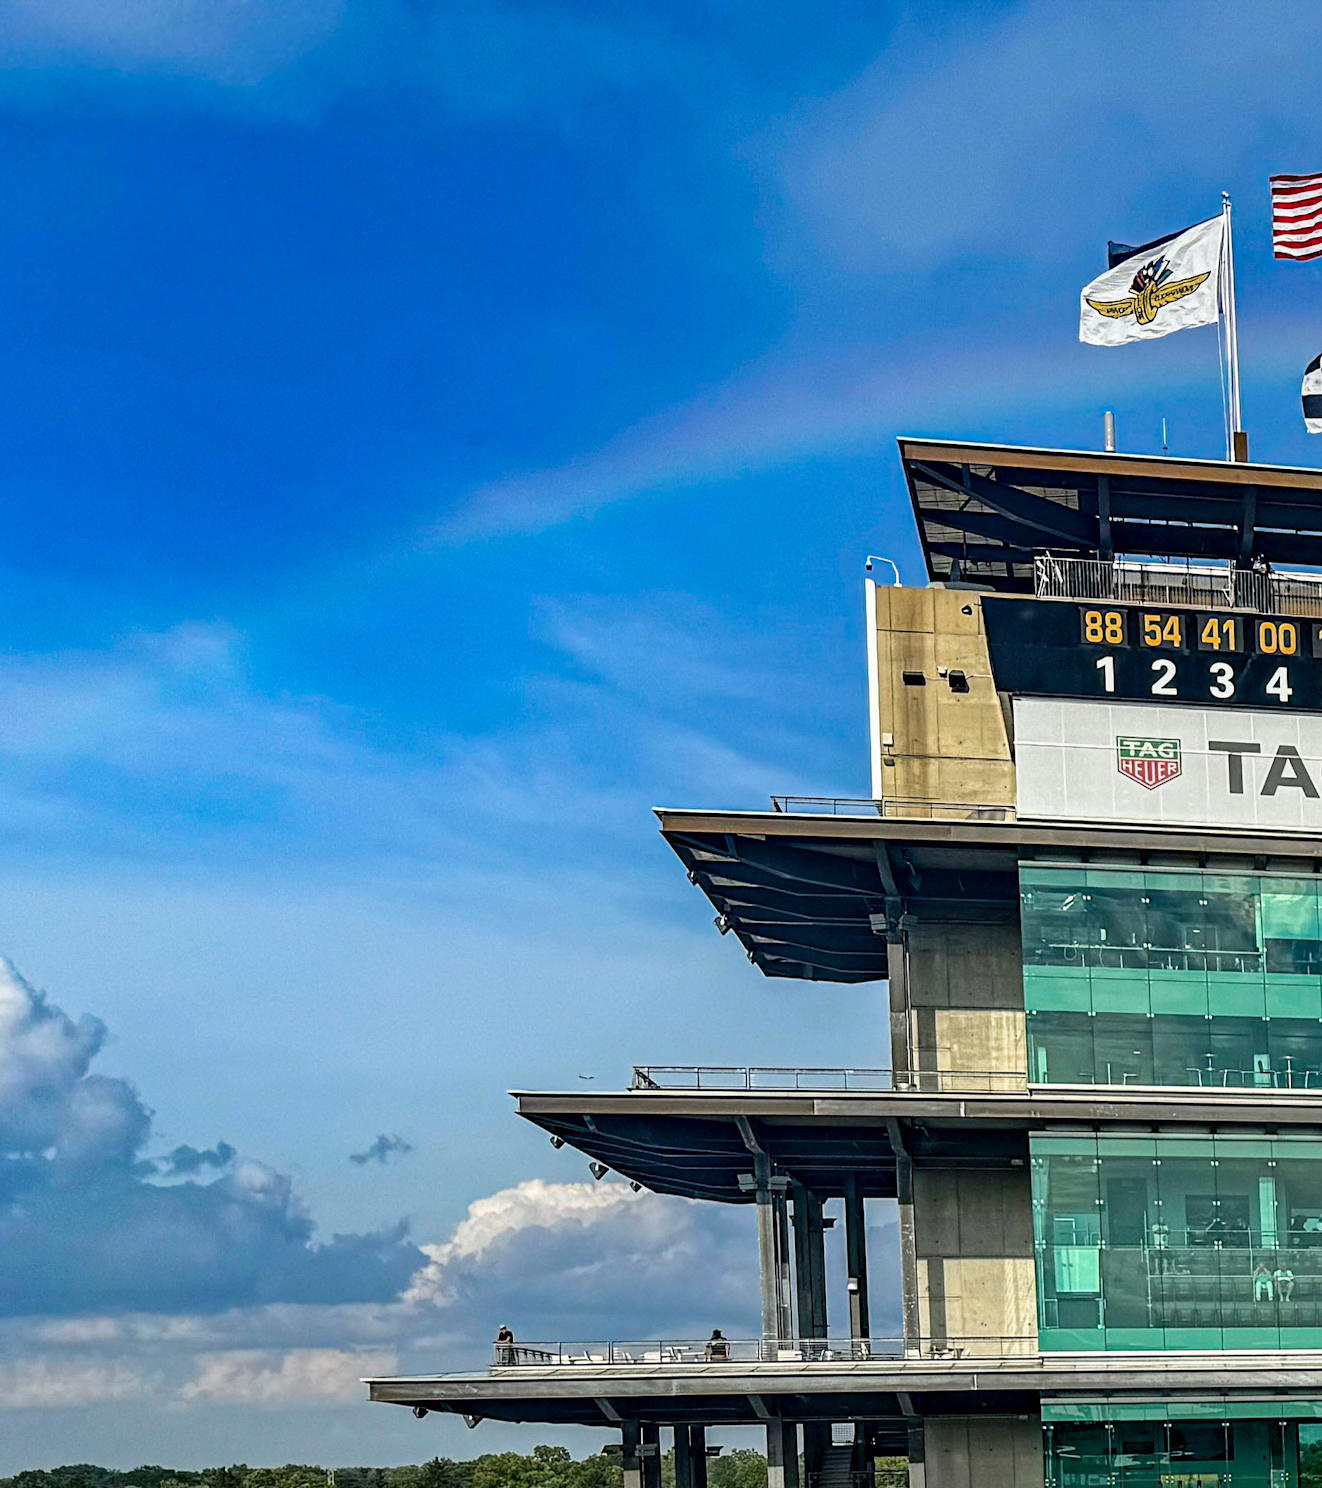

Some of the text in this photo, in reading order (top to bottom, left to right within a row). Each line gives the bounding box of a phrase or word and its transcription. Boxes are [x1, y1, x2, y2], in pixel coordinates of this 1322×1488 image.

[1085, 611, 1123, 644] 88
[1144, 615, 1182, 647] 54
[1201, 618, 1236, 650] 41
[1259, 622, 1297, 655] 00
[1096, 656, 1115, 692] 1
[1151, 659, 1177, 695] 2
[1209, 662, 1235, 699] 3
[1266, 667, 1293, 702] 4
[1123, 741, 1175, 758] TAG
[1122, 760, 1177, 785] HEUER
